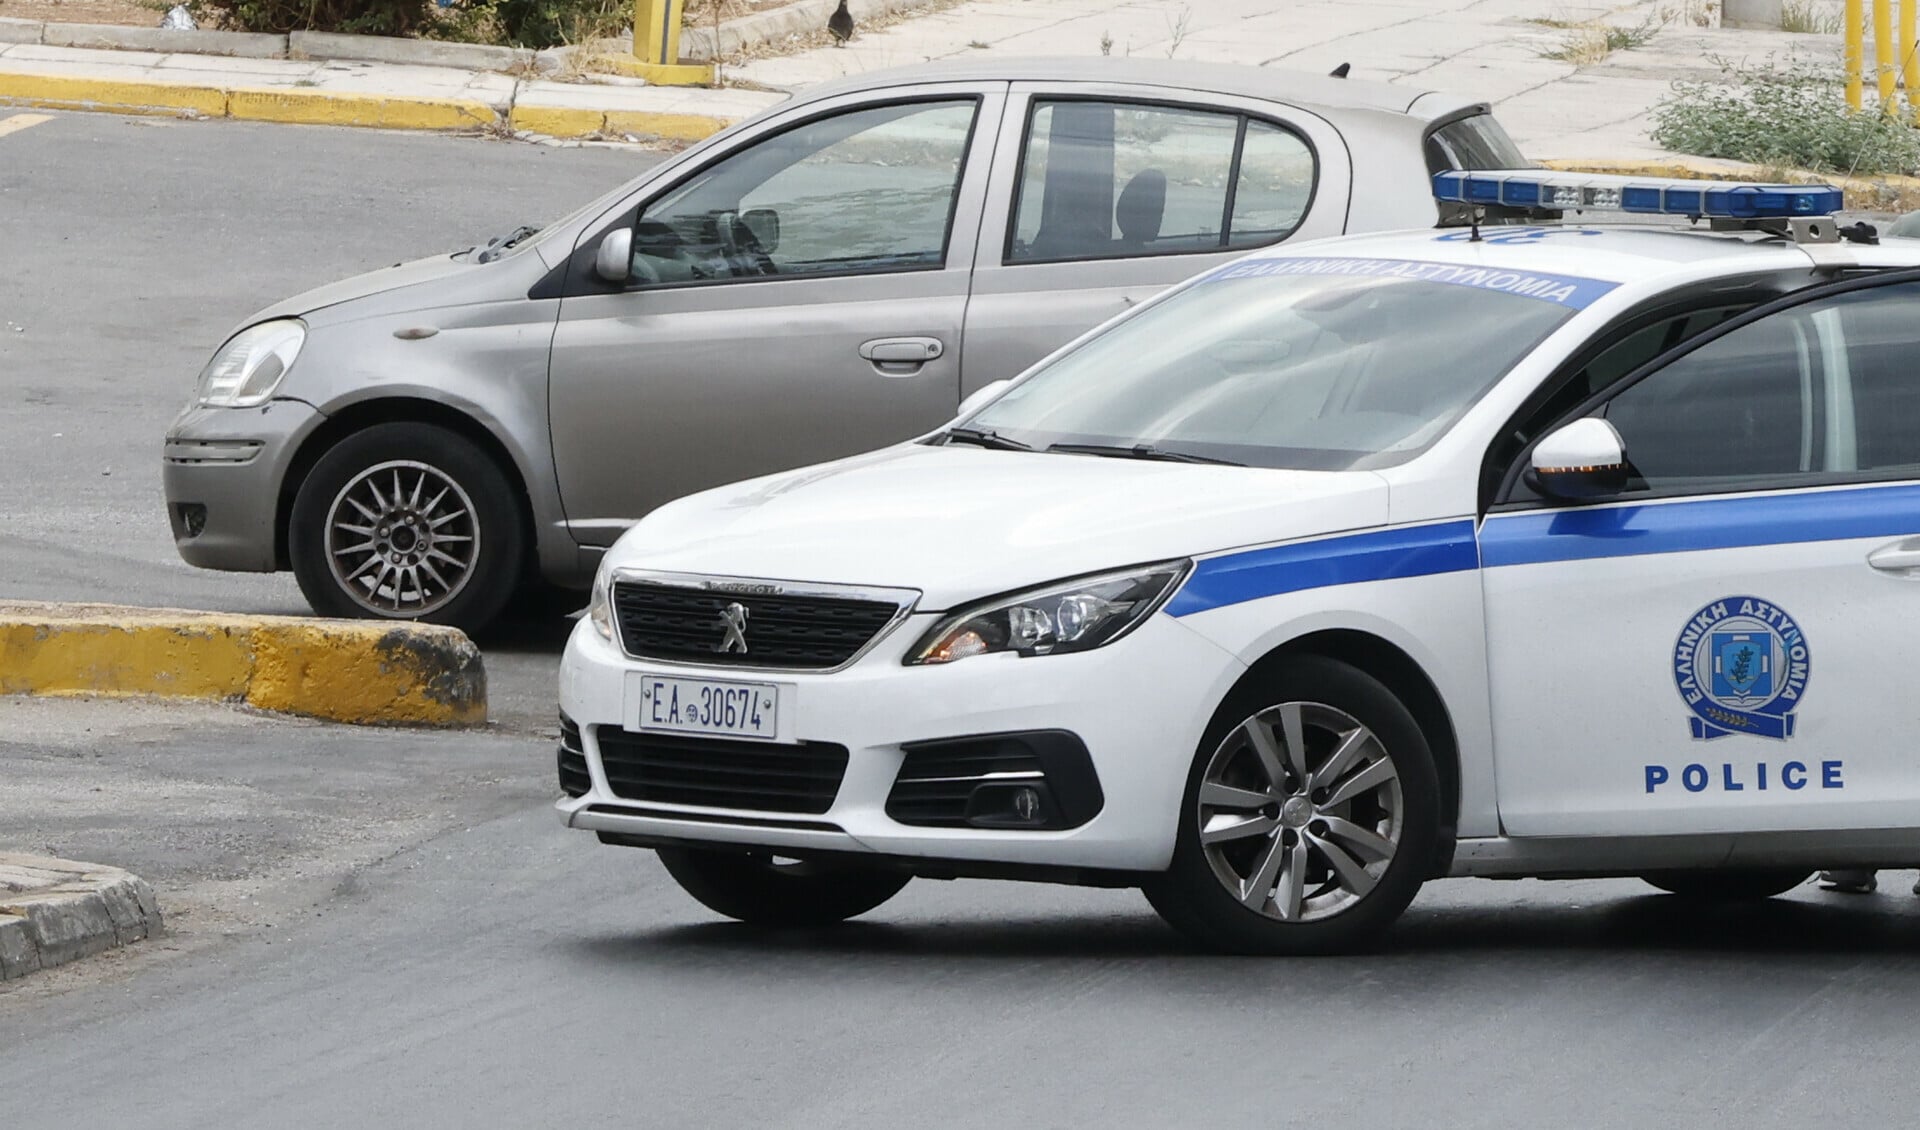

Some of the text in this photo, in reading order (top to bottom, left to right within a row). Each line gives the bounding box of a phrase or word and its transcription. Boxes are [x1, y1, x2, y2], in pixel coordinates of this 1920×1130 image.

[1377, 260, 1578, 302] ΑΣΤΥΝΟΜΙΑ
[1677, 599, 1806, 705] ΕΛΛΗΝΙΚΗ ΑΣΤΥΝΟΜΙΑ
[700, 686, 760, 730] 30674
[1645, 760, 1844, 794] POLICE
